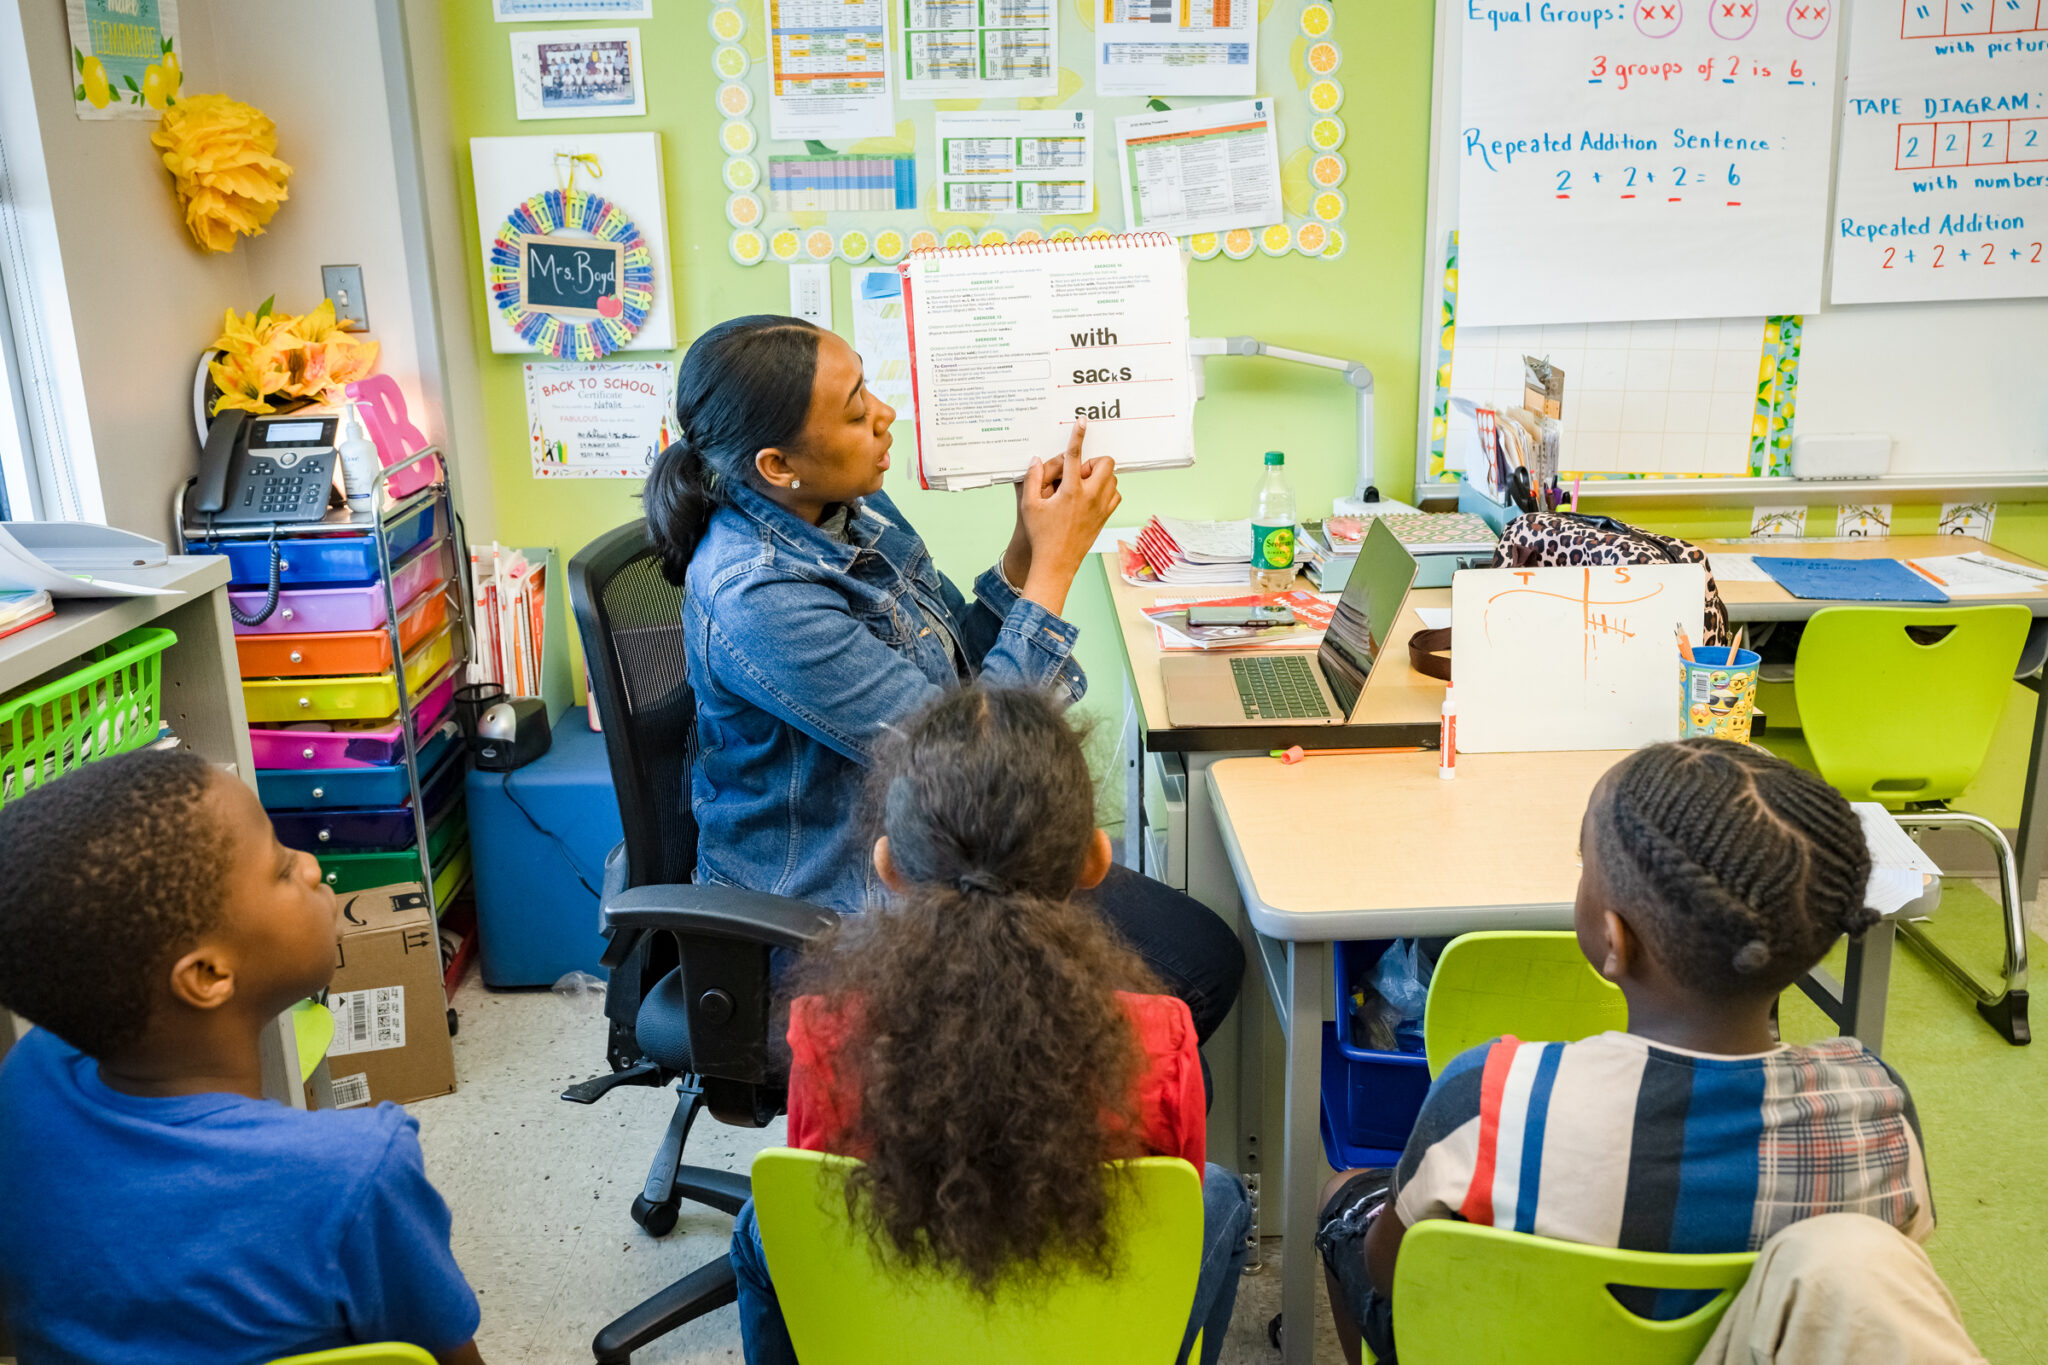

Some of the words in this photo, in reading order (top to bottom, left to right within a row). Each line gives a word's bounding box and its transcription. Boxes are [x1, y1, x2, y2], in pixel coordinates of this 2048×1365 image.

[1468, 0, 1531, 31] Equal
[1541, 0, 1625, 30] Groups:
[93, 19, 159, 59] LEMONADE
[1935, 40, 1975, 56] with
[1987, 37, 2048, 59] pictur
[1591, 55, 1607, 78] 3
[1615, 61, 1683, 91] groups
[1697, 57, 1715, 81] of
[1727, 55, 1741, 77] 2
[1753, 60, 1771, 78] is
[1849, 98, 1903, 116] TAPE
[1924, 92, 2043, 119] DIAGRAM:
[1463, 128, 1572, 173] Repeated
[1580, 131, 1657, 151] Addition
[1905, 136, 1920, 158] 2
[1945, 134, 1959, 152] 2
[1982, 132, 1996, 148] 2
[2024, 130, 2039, 147] 2
[1556, 170, 1572, 191] 2
[1624, 166, 1637, 187] 2
[1672, 166, 1687, 186] 2
[1727, 163, 1741, 186] 6
[1913, 175, 1957, 193] with
[1841, 216, 1930, 243] Repeated
[1938, 213, 2025, 236] Addition
[1882, 247, 1896, 269] 2
[1933, 244, 1945, 268] 2
[1980, 243, 1996, 266] 2
[2030, 242, 2043, 264] 2
[530, 248, 575, 296] Mrs.
[572, 251, 616, 295] Boyd
[1070, 327, 1118, 347] with
[542, 380, 576, 397] BACK
[579, 378, 597, 389] TO
[604, 378, 657, 396] SCHOOL
[1073, 367, 1132, 384] sacks
[578, 391, 623, 399] Certificate
[1075, 399, 1121, 420] said
[1513, 571, 1536, 586] T
[1614, 567, 1632, 584] S
